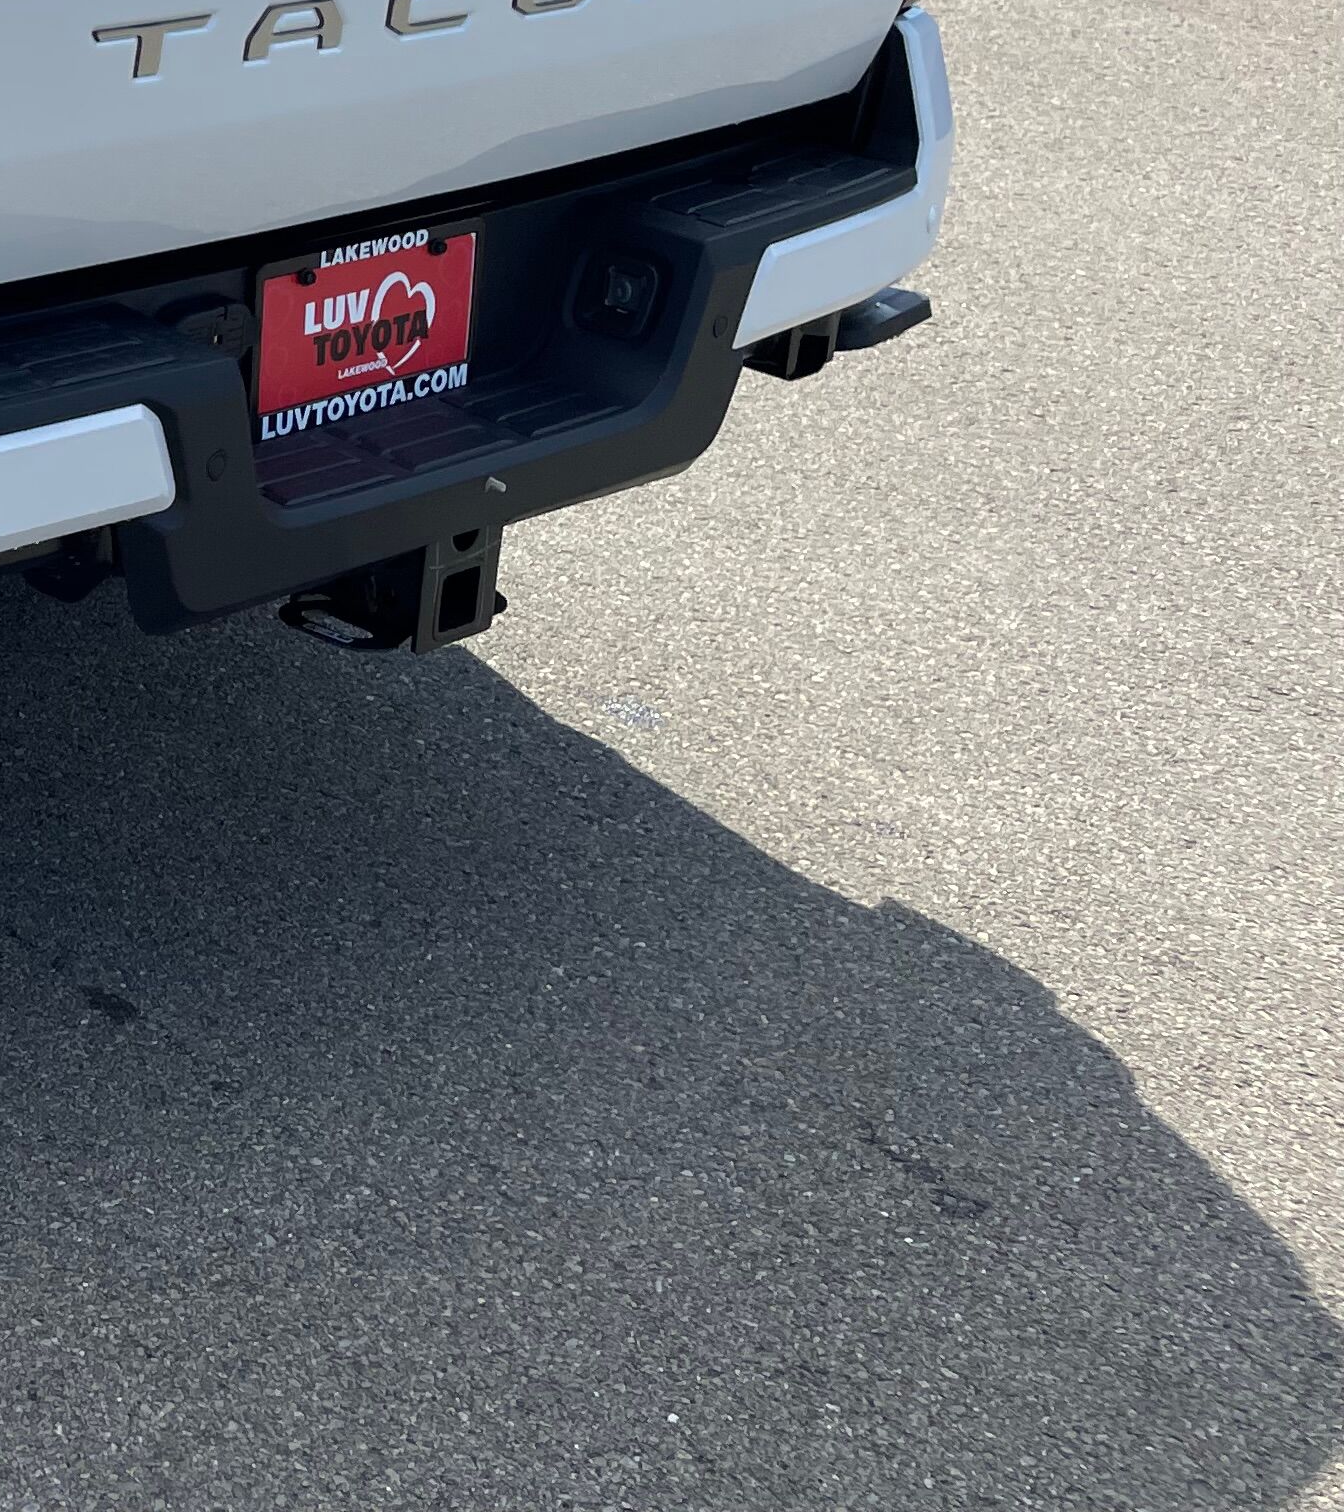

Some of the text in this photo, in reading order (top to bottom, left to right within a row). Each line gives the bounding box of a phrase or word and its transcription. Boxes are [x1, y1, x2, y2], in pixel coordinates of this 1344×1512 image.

[320, 229, 429, 269] LAKEWOOD
[304, 288, 371, 336] LUV
[313, 309, 429, 366] TOYOTA
[337, 357, 389, 380] LAKEWOOD
[261, 363, 469, 441] LUVTOYOTA.COM
